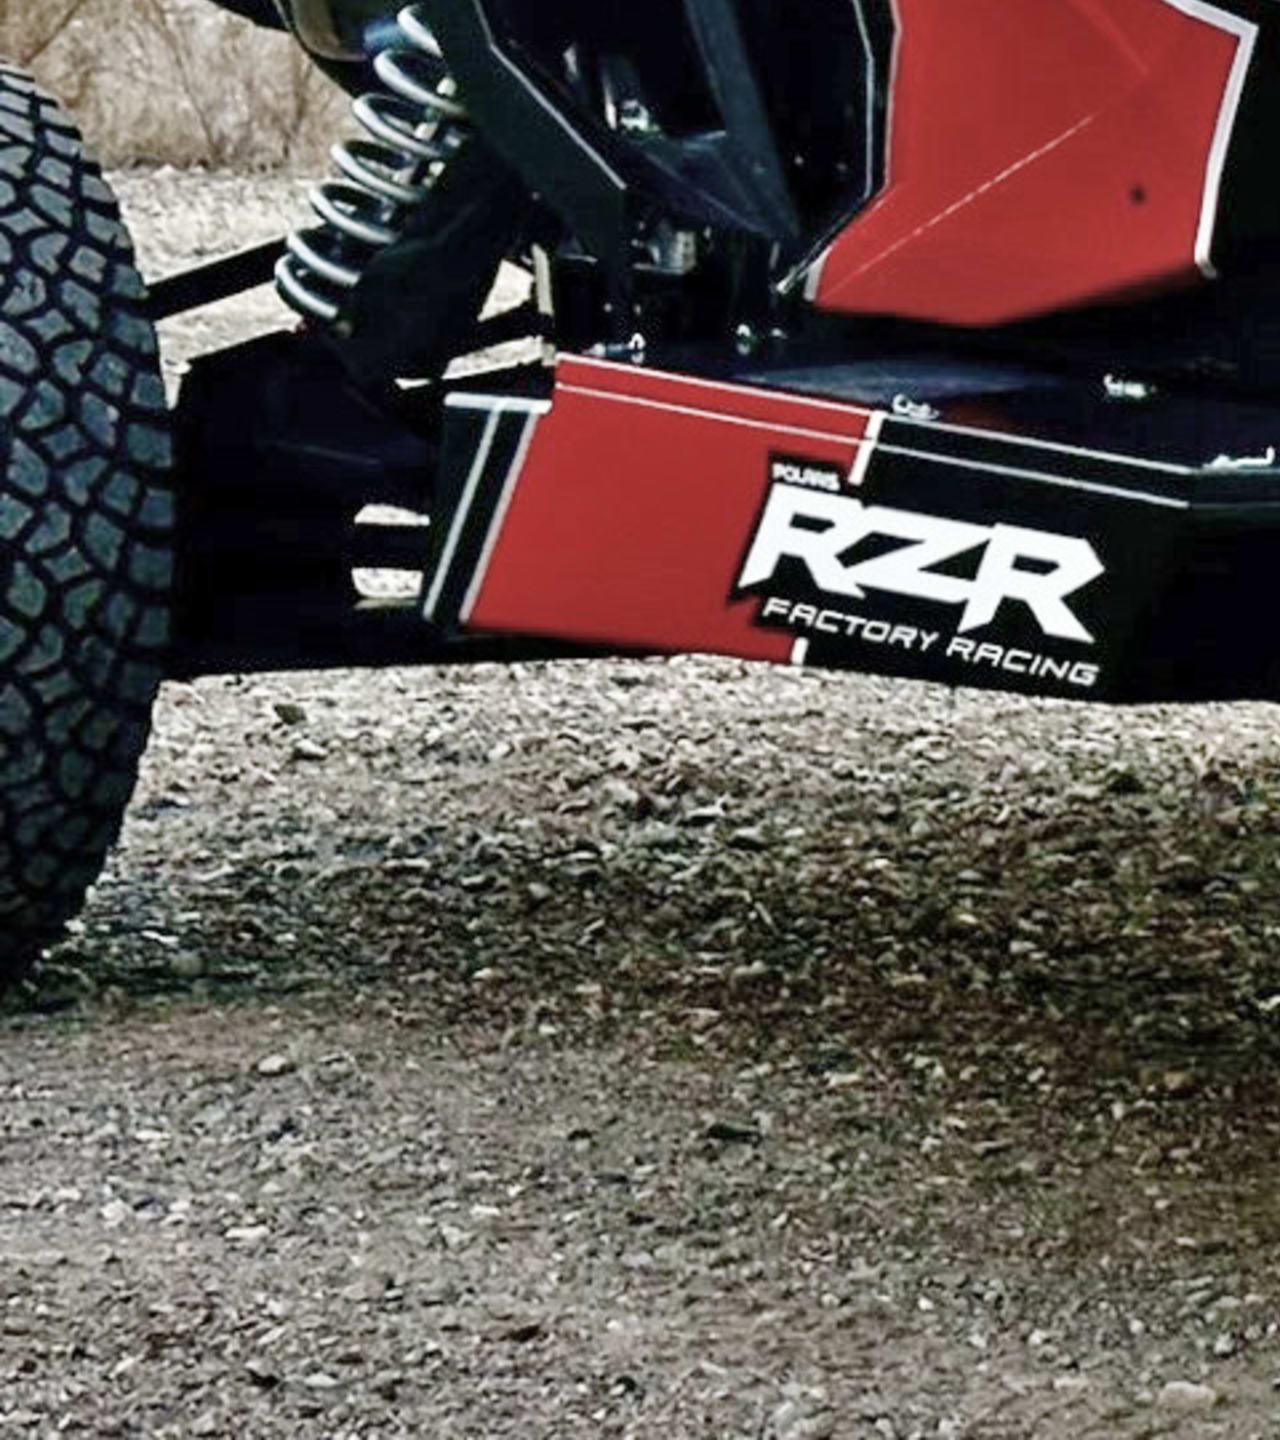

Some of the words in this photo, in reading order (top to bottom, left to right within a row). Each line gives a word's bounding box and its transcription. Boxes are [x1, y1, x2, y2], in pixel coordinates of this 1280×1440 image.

[738, 482, 1105, 644] RZR
[762, 597, 938, 651] FACTORY
[945, 635, 1100, 687] RACING
